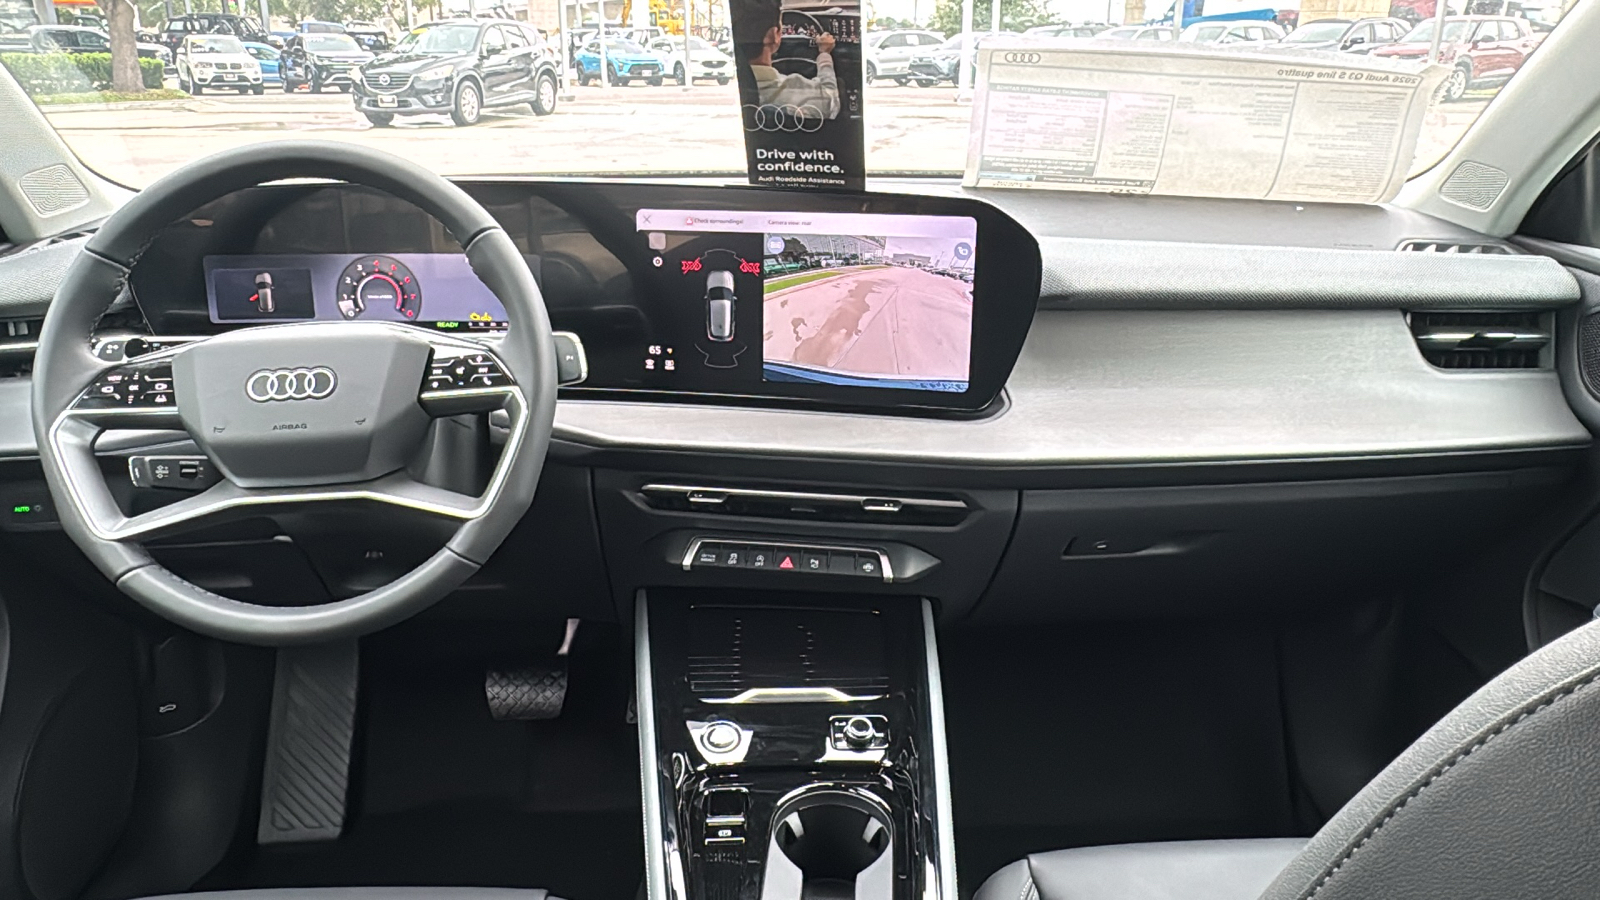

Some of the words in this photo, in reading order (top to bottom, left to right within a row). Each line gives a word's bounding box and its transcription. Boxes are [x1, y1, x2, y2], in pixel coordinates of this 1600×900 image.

[756, 148, 796, 160] Drive
[799, 150, 834, 161] with
[757, 161, 845, 174] confidence.
[808, 177, 846, 185] Assistance
[345, 276, 352, 284] 2
[648, 344, 661, 355] 65
[272, 423, 308, 431] AIRBAG
